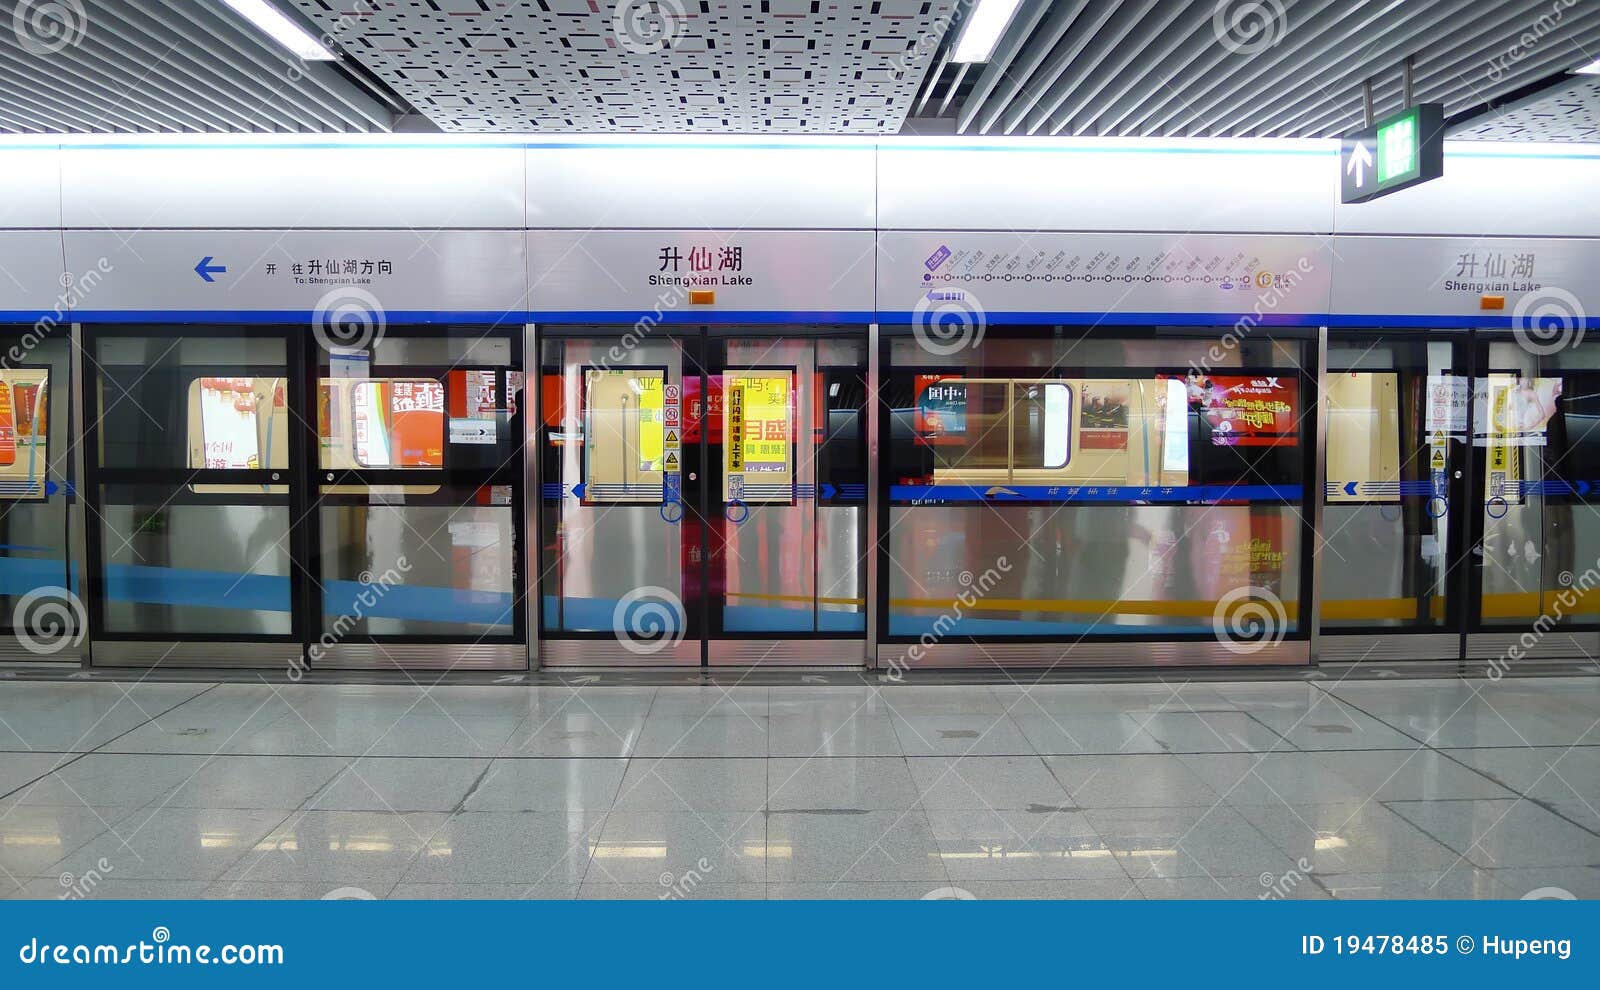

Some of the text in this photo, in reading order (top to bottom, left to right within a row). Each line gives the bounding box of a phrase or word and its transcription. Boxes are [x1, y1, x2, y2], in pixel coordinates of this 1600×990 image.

[659, 246, 742, 271] 升仙湖
[1456, 253, 1535, 278] 升仙湖
[648, 275, 753, 288] Shengxian Lake
[1444, 281, 1541, 293] Shengxian Lake
